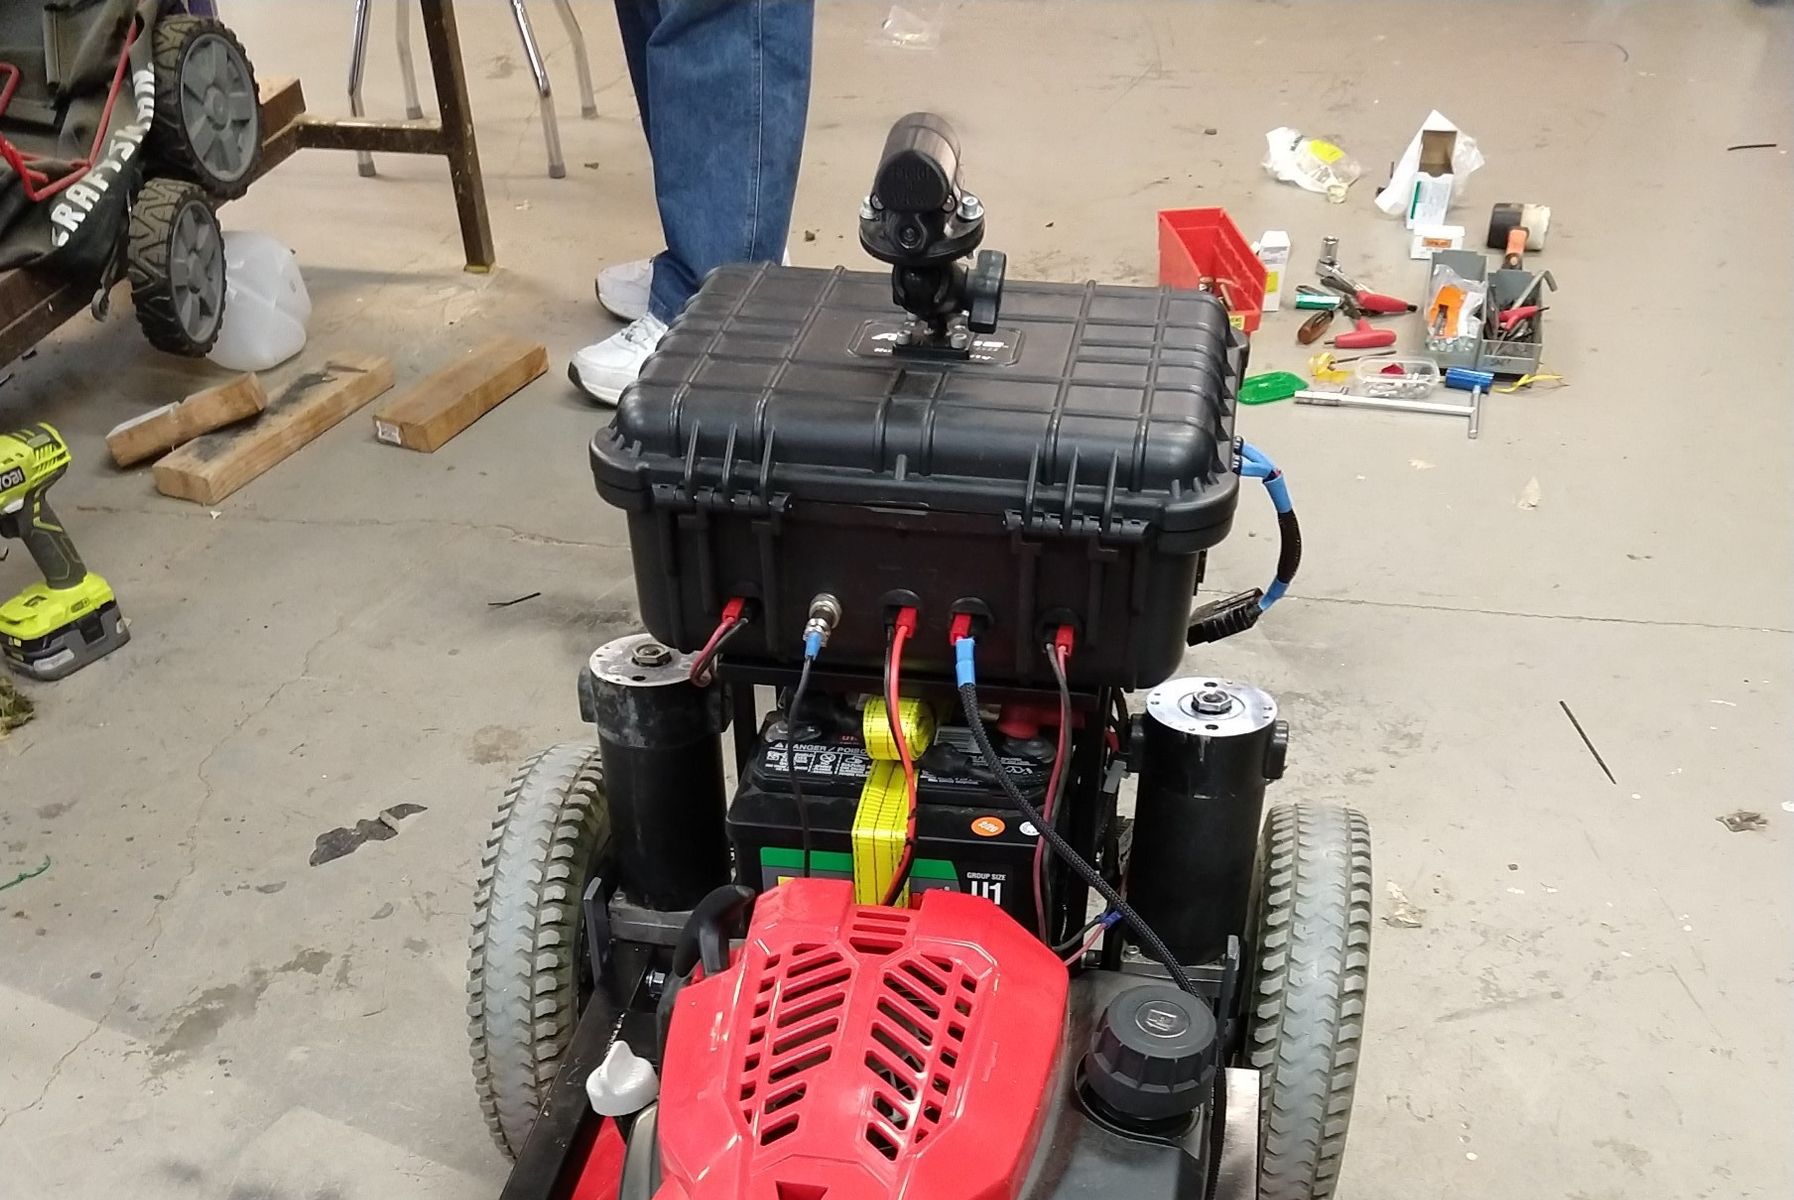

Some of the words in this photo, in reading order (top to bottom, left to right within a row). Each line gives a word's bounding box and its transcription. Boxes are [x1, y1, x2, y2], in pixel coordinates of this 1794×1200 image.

[785, 743, 827, 752] ANGER
[837, 746, 869, 754] POISO
[966, 871, 991, 880] GROUP
[991, 873, 1007, 881] SIZE
